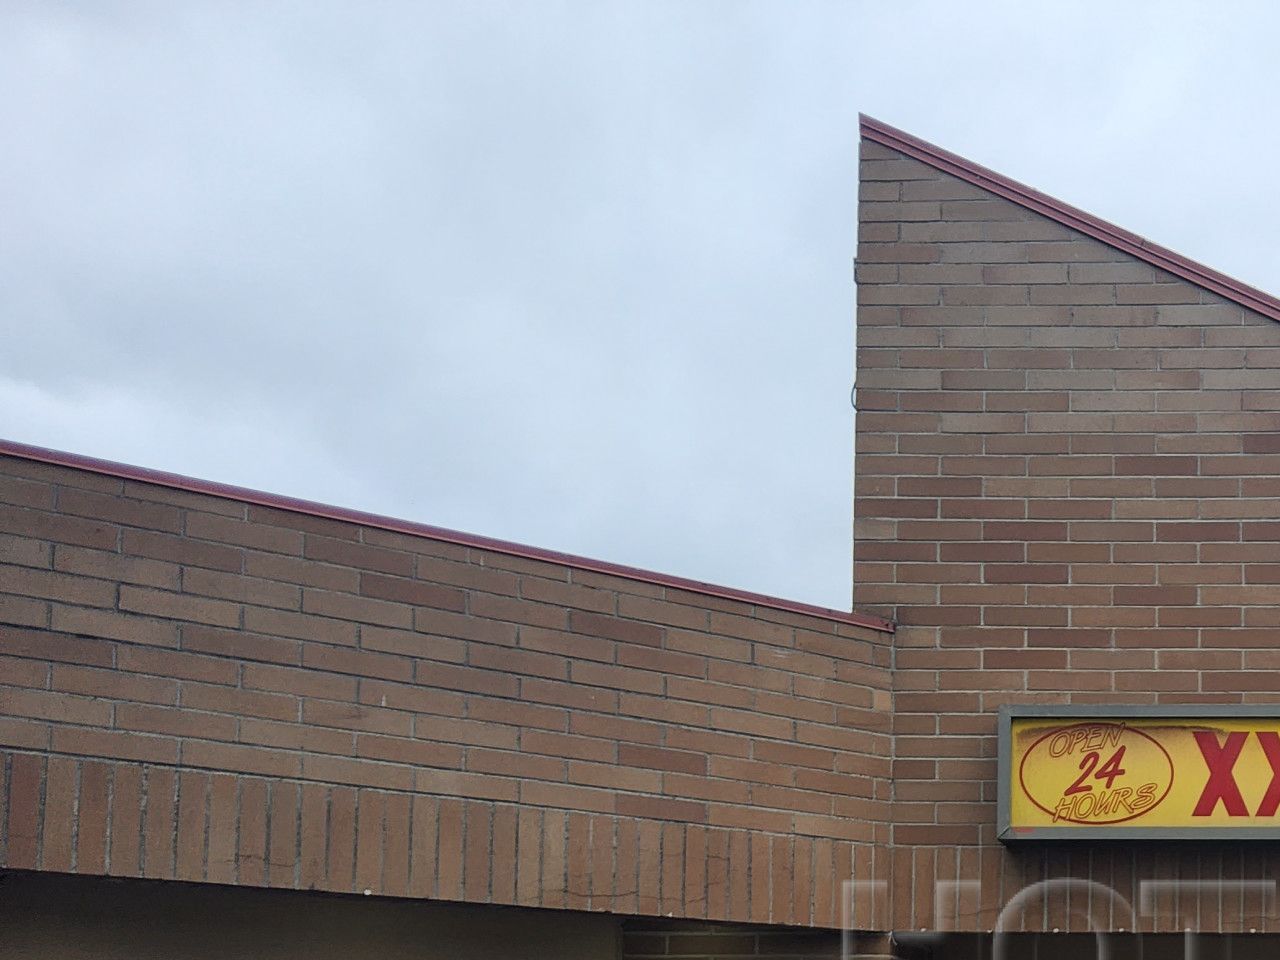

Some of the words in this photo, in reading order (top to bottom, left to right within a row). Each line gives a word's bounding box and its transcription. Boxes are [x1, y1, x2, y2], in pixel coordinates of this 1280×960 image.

[1050, 722, 1126, 758] OPEN
[1064, 745, 1126, 796] 24
[1053, 783, 1158, 823] HOURS
